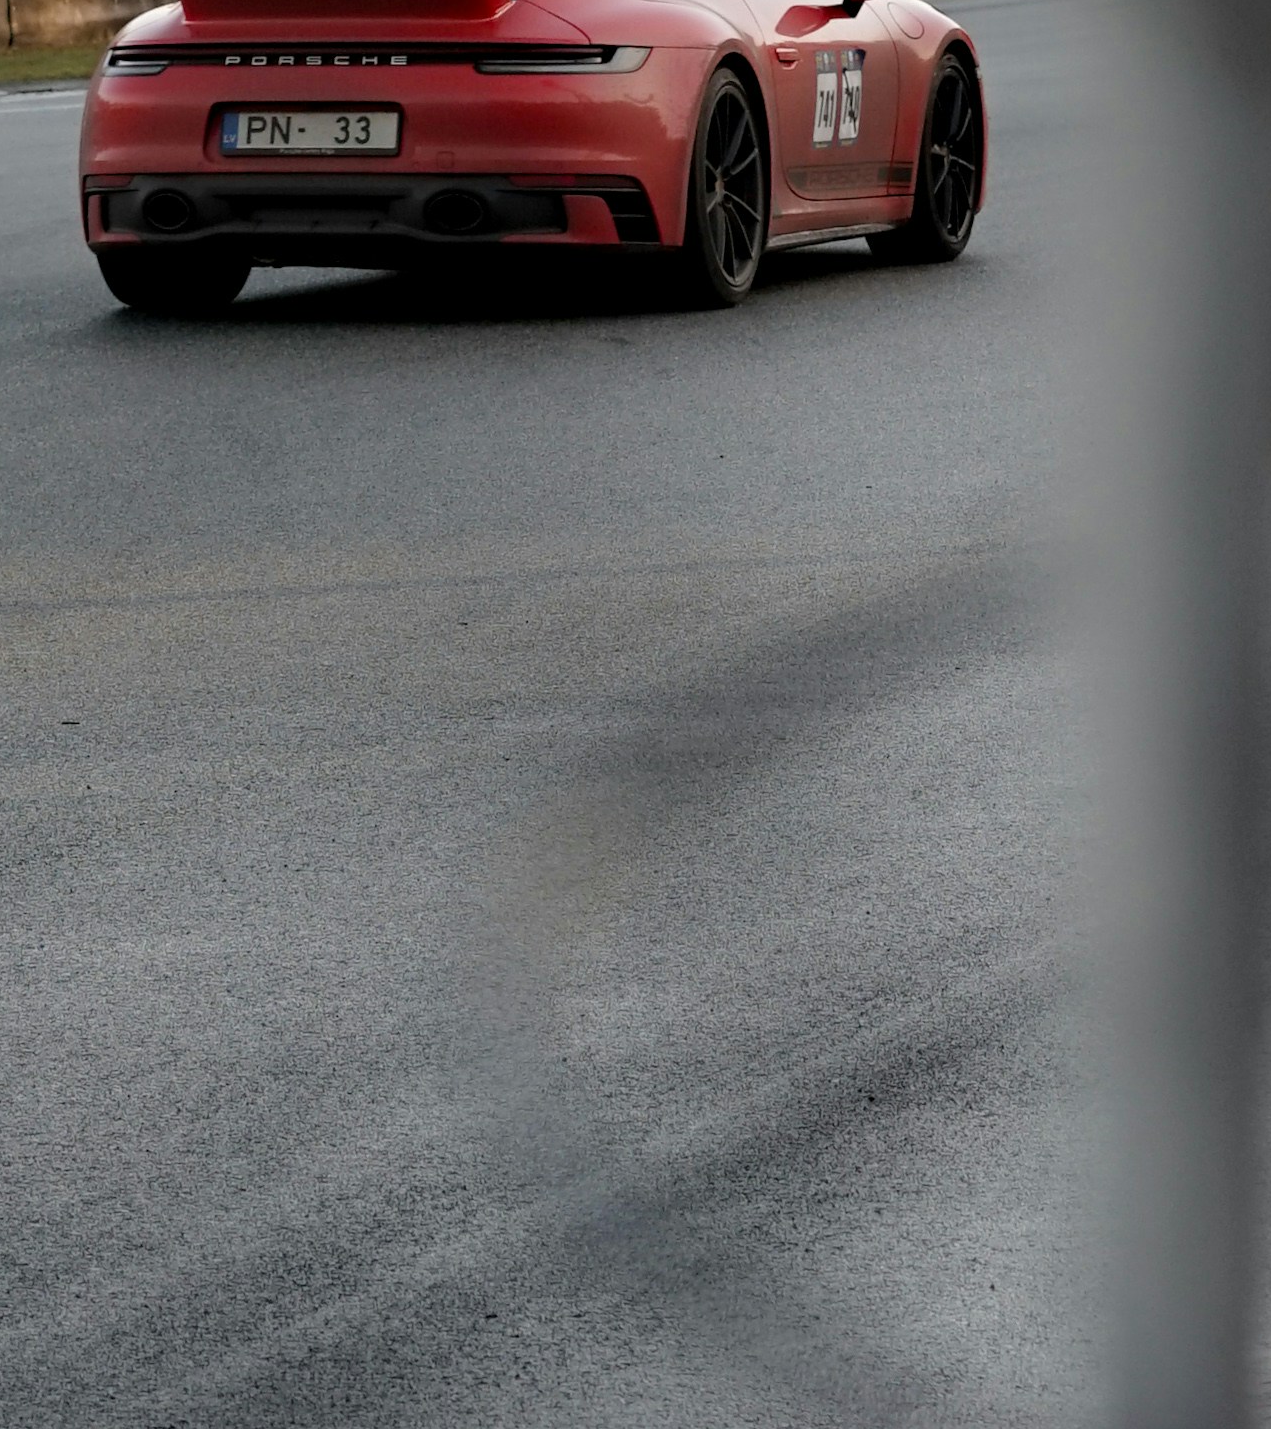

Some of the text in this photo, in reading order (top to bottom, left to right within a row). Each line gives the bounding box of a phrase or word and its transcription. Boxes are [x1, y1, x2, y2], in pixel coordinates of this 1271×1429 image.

[224, 55, 408, 66] PORSCHE
[817, 89, 835, 128] 741
[223, 134, 237, 143] LV
[334, 116, 371, 144] 33
